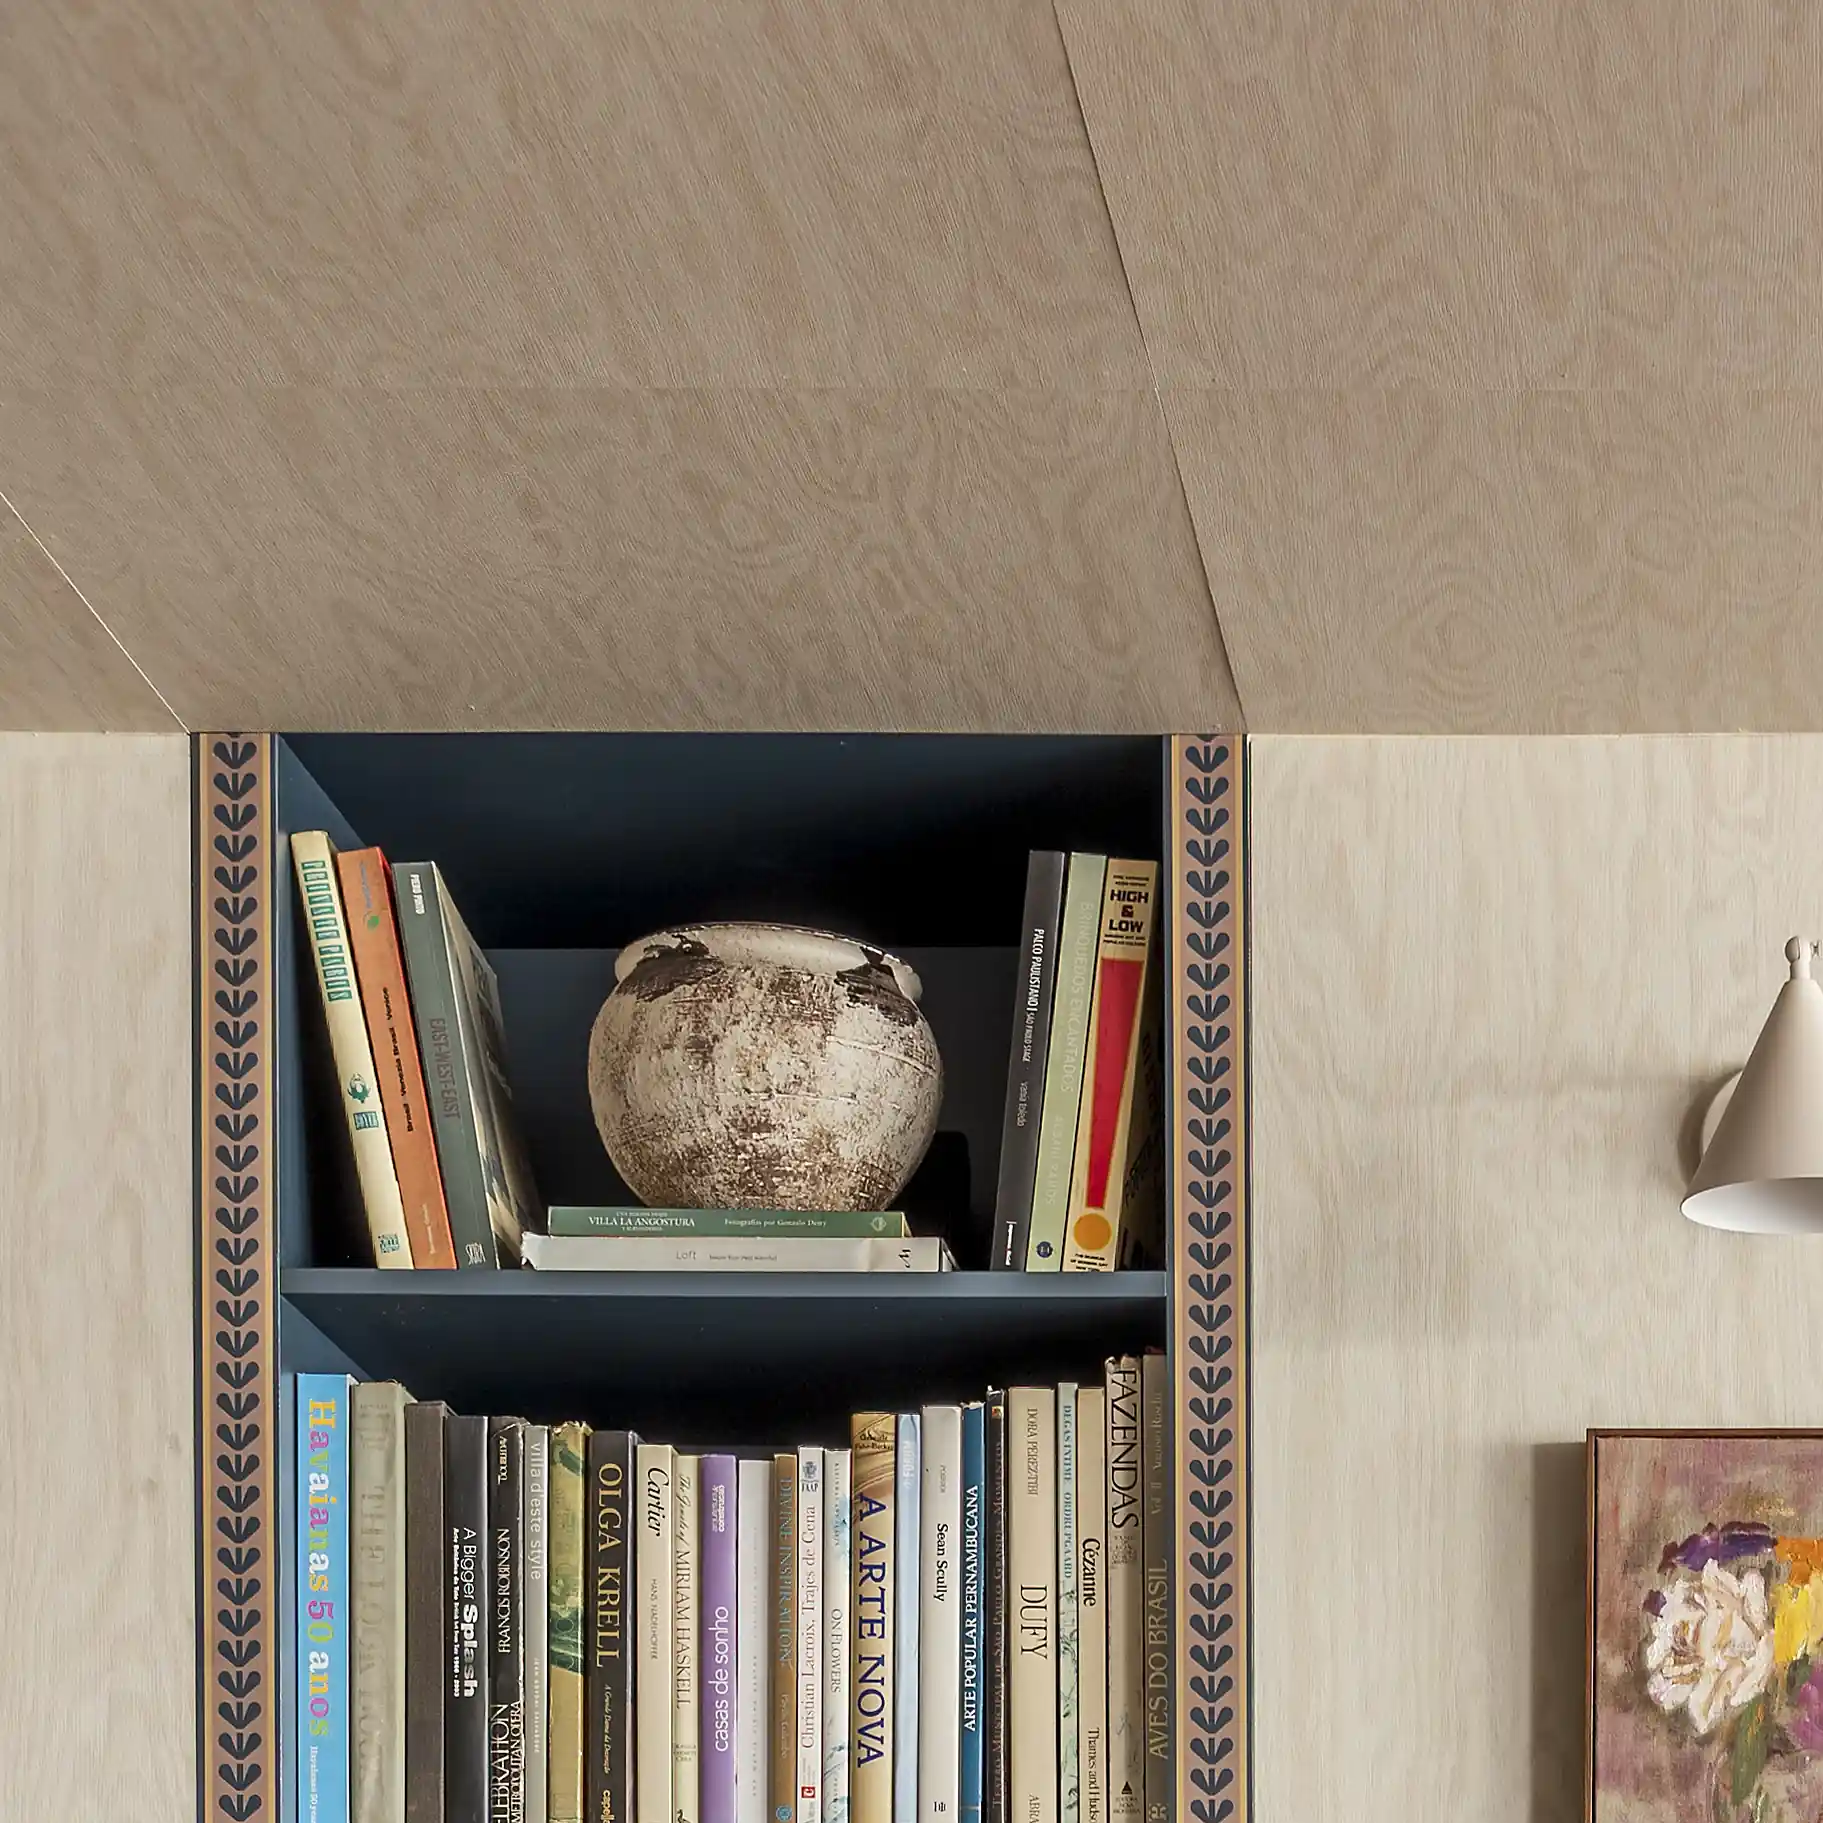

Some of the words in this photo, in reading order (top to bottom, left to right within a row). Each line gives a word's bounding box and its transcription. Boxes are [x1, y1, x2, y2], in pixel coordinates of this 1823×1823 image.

[1110, 889, 1149, 903] HIGH
[1032, 928, 1045, 954] PALCO
[1072, 903, 1095, 994] BRINQUEDOS
[1109, 919, 1143, 933] LOW
[318, 945, 352, 1001] PARIS
[1027, 956, 1043, 1007] PAULISTANO
[429, 1018, 460, 1119] EAST-WEST-EAST
[1060, 998, 1081, 1092] ENCANTADOS
[1017, 1103, 1029, 1126] toledo
[588, 1216, 617, 1225] VILLA
[620, 1217, 632, 1226] LA
[635, 1217, 695, 1227] ANGOSTURA
[531, 1443, 543, 1478] villa
[1064, 1445, 1072, 1482] INTIME
[1111, 1368, 1139, 1529] FAZENDAS
[307, 1398, 336, 1592] Havaianas
[530, 1483, 545, 1533] d'este
[597, 1463, 622, 1551] OLGA
[645, 1468, 669, 1536] Cartier
[859, 1493, 887, 1523] A
[463, 1528, 476, 1539] A
[528, 1540, 544, 1580] style
[936, 1524, 948, 1556] Sean
[965, 1486, 979, 1614] PERNAMBUCANA
[461, 1545, 477, 1599] Bigger
[676, 1550, 691, 1623] MIRIAM
[858, 1532, 887, 1640] ARTE
[933, 1560, 949, 1602] Scully
[1082, 1538, 1100, 1607] Cézanne
[307, 1600, 335, 1642] 50
[595, 1567, 620, 1668] KRELL
[1020, 1585, 1047, 1659] DUFY
[1149, 1559, 1167, 1645] BRASIL
[462, 1604, 478, 1697] Splash
[709, 1607, 728, 1664] sonho
[965, 1618, 977, 1688] POPULAR
[309, 1652, 333, 1736] anos
[676, 1627, 690, 1709] HASKELL
[709, 1669, 728, 1695] de
[1149, 1653, 1168, 1688] DO
[713, 1700, 728, 1751] casas
[858, 1654, 885, 1768] NOVA
[965, 1692, 977, 1731] ARTE
[1150, 1695, 1167, 1759] AVES
[1087, 1728, 1099, 1767] Thames
[1088, 1770, 1099, 1789] and
